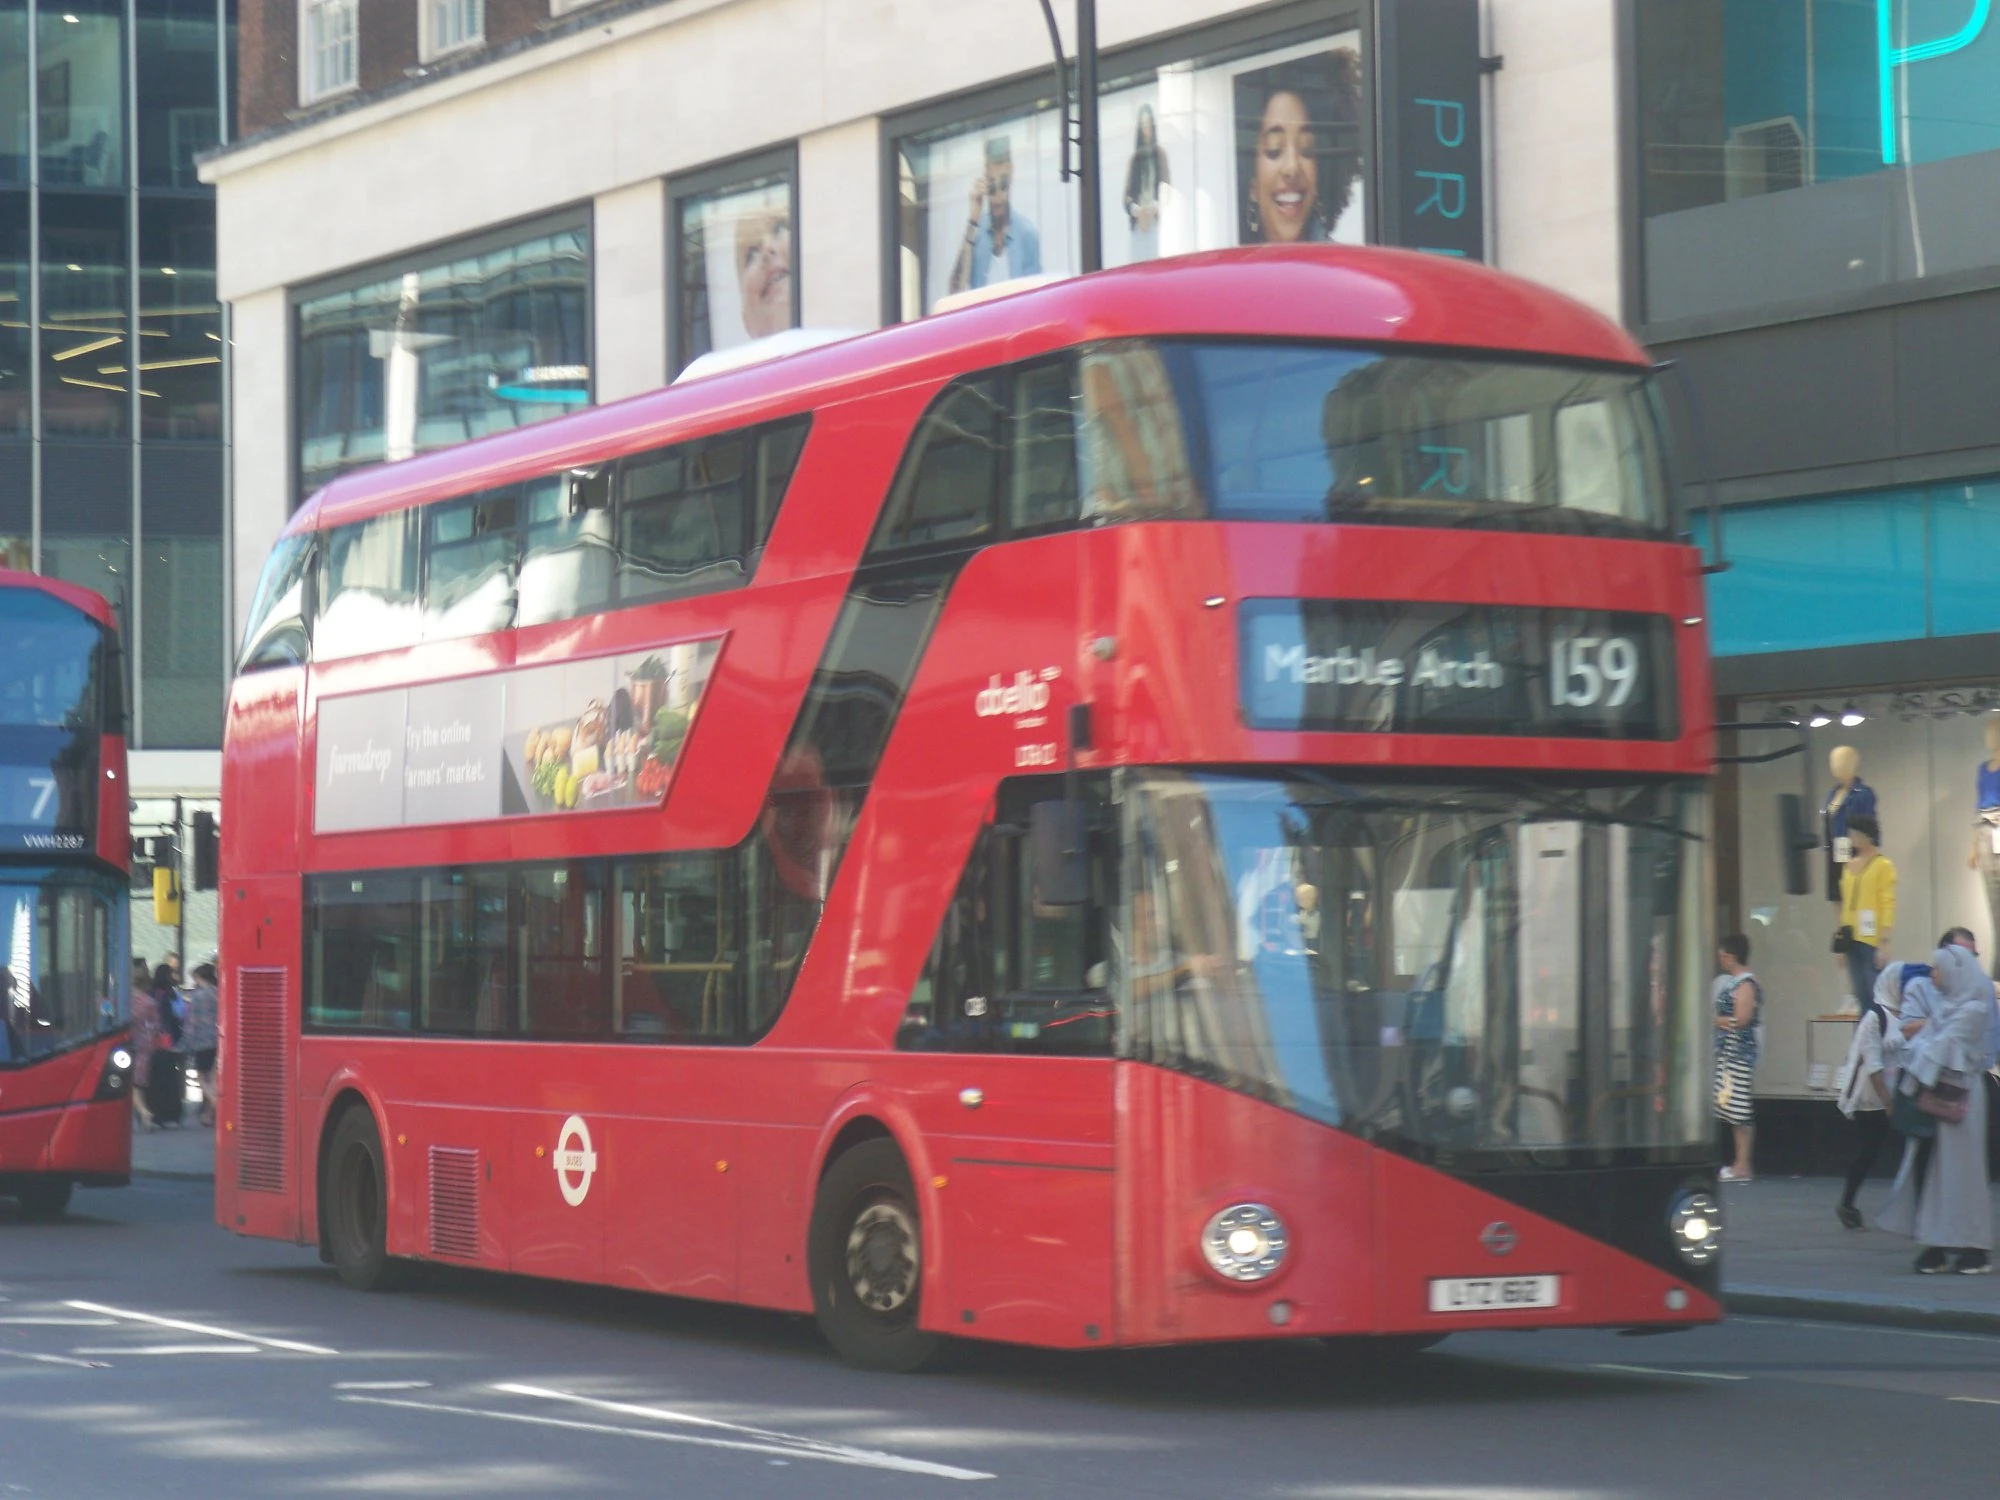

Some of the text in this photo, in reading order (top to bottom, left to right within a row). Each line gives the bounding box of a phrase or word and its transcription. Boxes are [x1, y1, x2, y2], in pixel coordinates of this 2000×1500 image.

[1264, 643, 1504, 689] Marble Arch
[1550, 636, 1638, 707] 159
[422, 721, 439, 748] the
[440, 719, 471, 745] online
[28, 778, 57, 820] 7
